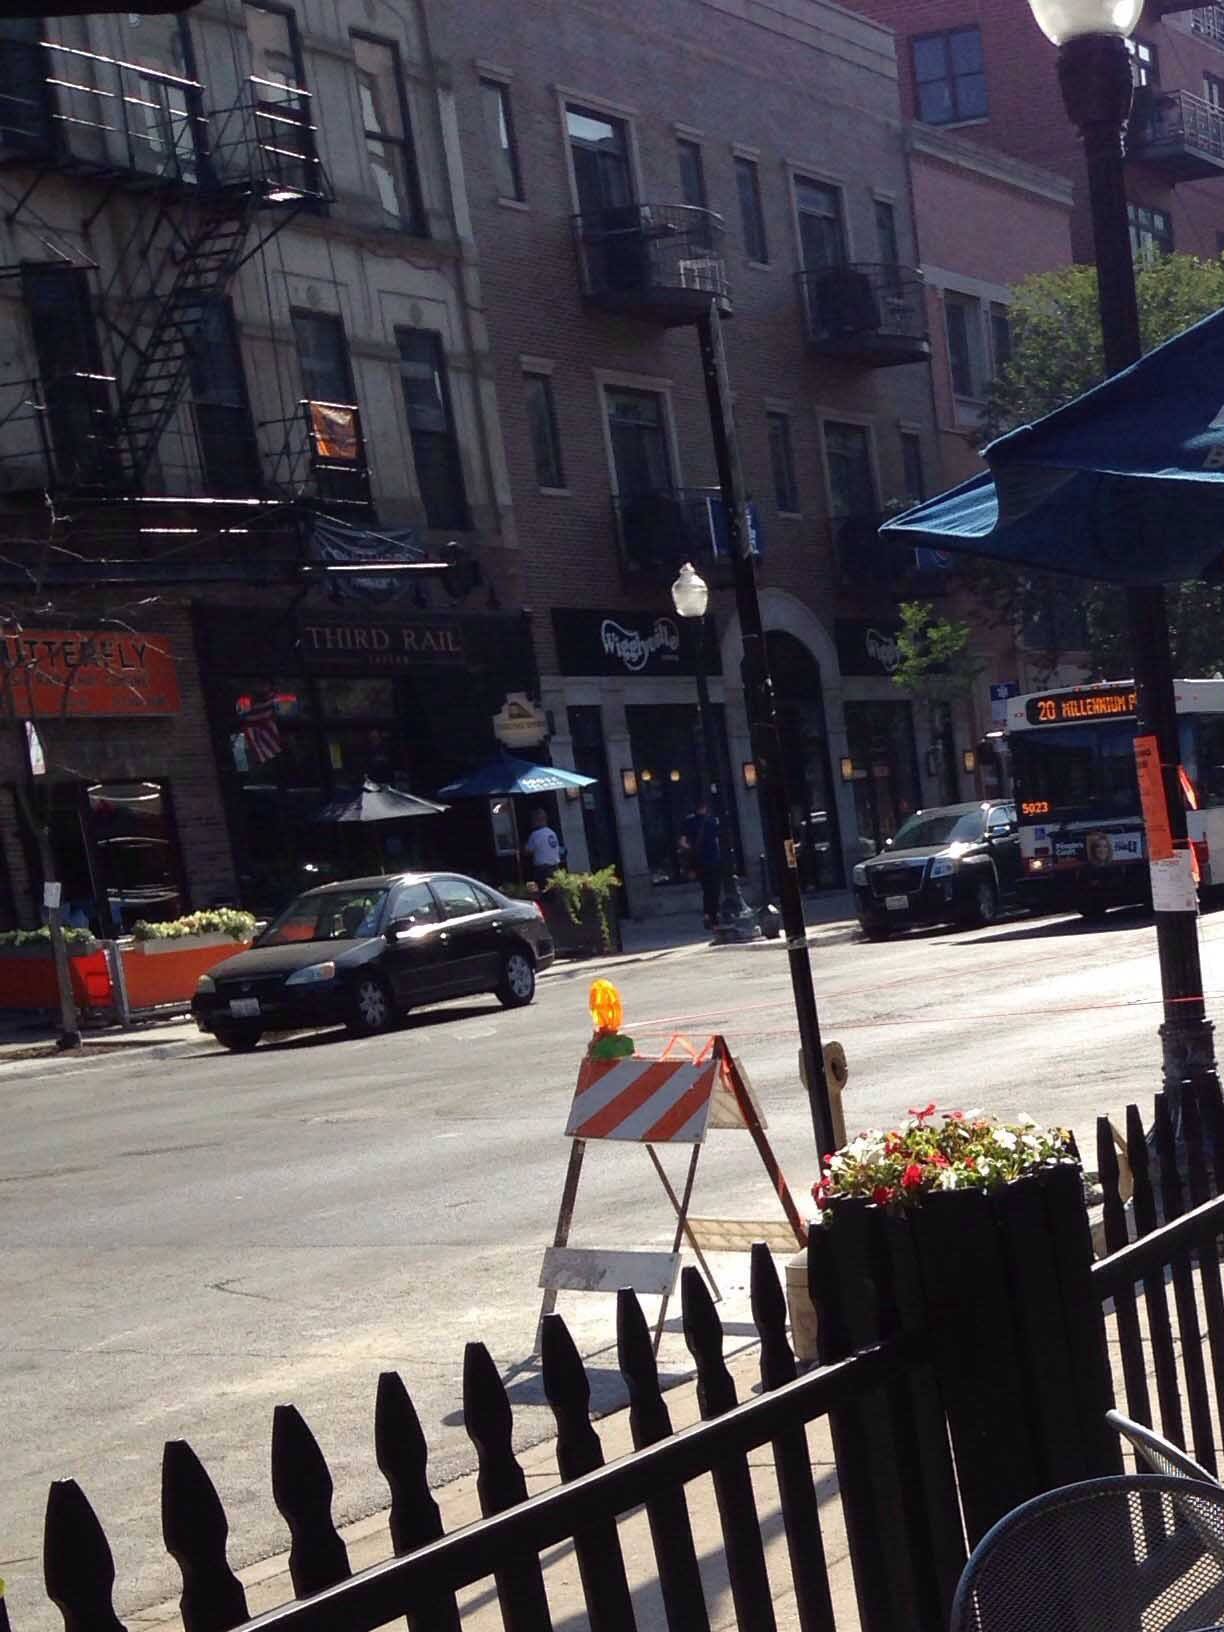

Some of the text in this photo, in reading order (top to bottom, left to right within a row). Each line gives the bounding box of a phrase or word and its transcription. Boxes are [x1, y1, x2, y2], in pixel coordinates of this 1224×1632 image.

[305, 626, 462, 652] THIRD RAIL
[2, 640, 146, 668] UTTERFLY
[1037, 700, 1057, 721] 20
[1062, 694, 1126, 719] MILLENNIUM
